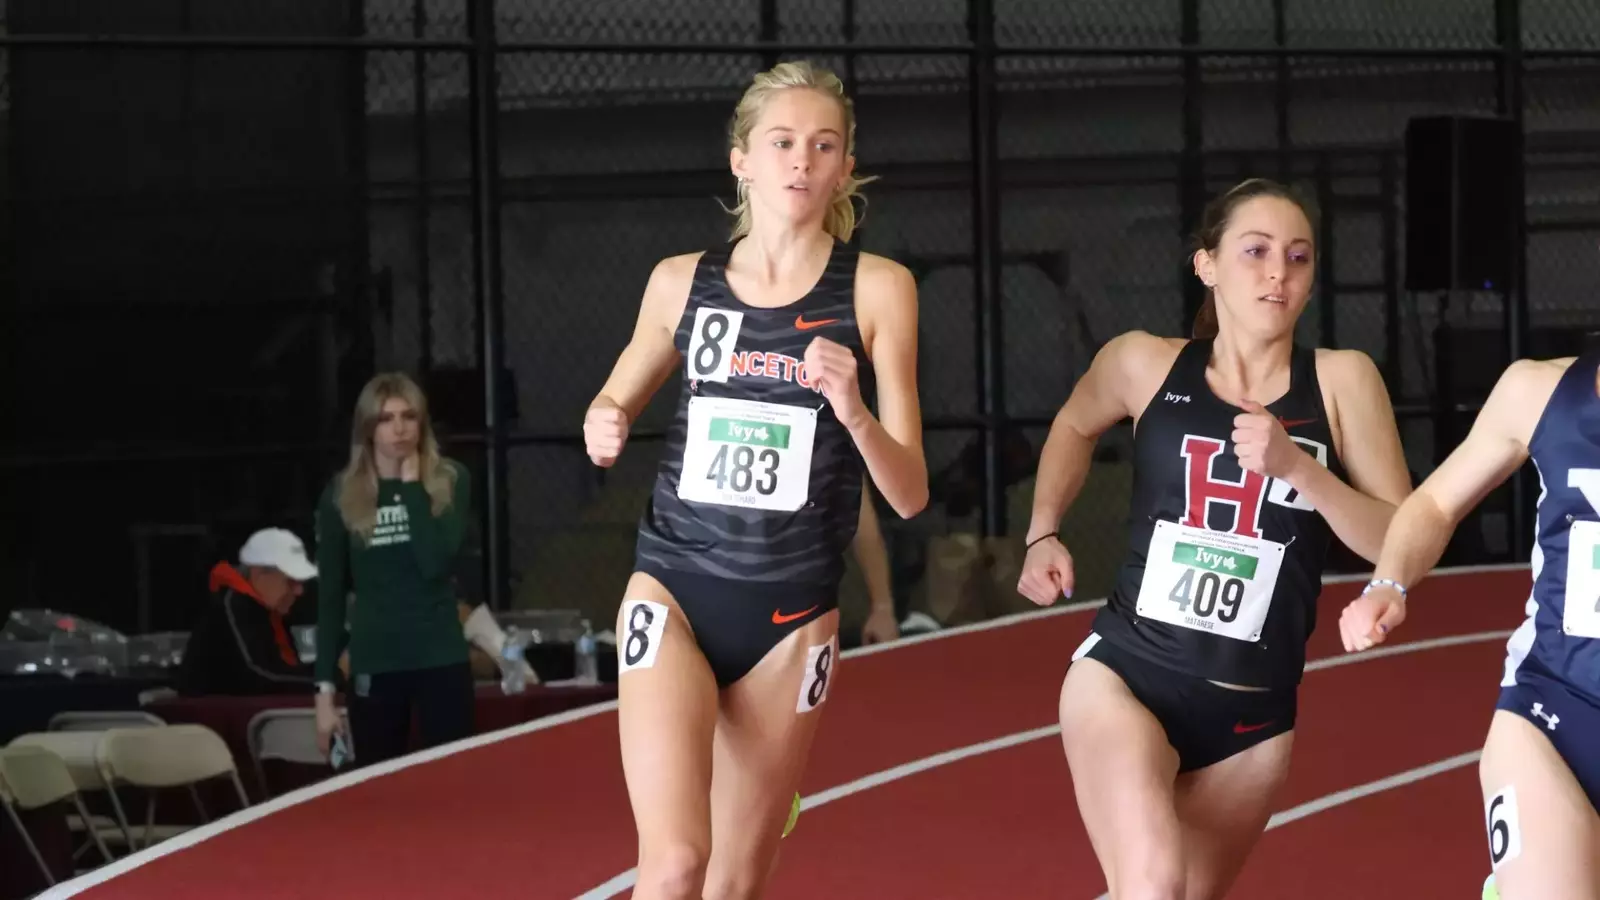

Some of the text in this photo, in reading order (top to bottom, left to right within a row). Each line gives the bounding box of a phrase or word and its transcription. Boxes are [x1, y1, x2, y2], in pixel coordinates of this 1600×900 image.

[694, 313, 729, 375] 8
[728, 351, 830, 394] NCETO
[1164, 391, 1183, 403] Ivy
[727, 421, 754, 441] Ivy
[706, 444, 780, 495] 483
[1179, 434, 1263, 539] H
[1195, 547, 1223, 569] Ivy
[1168, 568, 1245, 623] 409
[625, 603, 654, 666] 8
[807, 645, 831, 707] 8
[1489, 795, 1509, 864] 6
